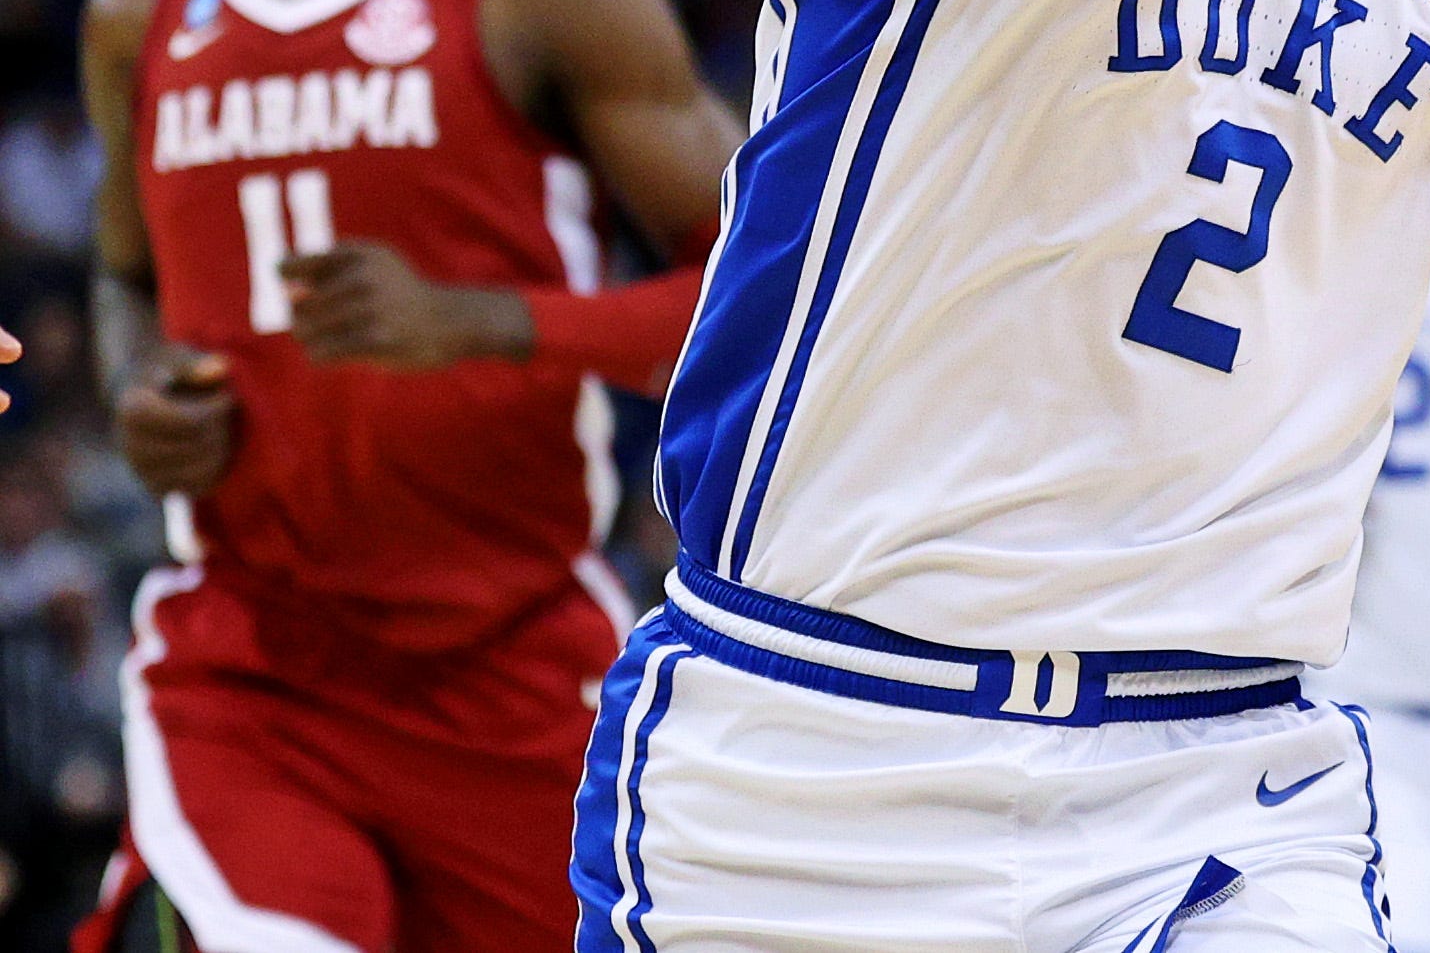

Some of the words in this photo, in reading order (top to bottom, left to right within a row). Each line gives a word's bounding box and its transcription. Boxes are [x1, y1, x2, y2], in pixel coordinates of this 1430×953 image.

[153, 66, 439, 173] ALABAMA
[1121, 118, 1294, 374] 2
[999, 649, 1081, 718] D
